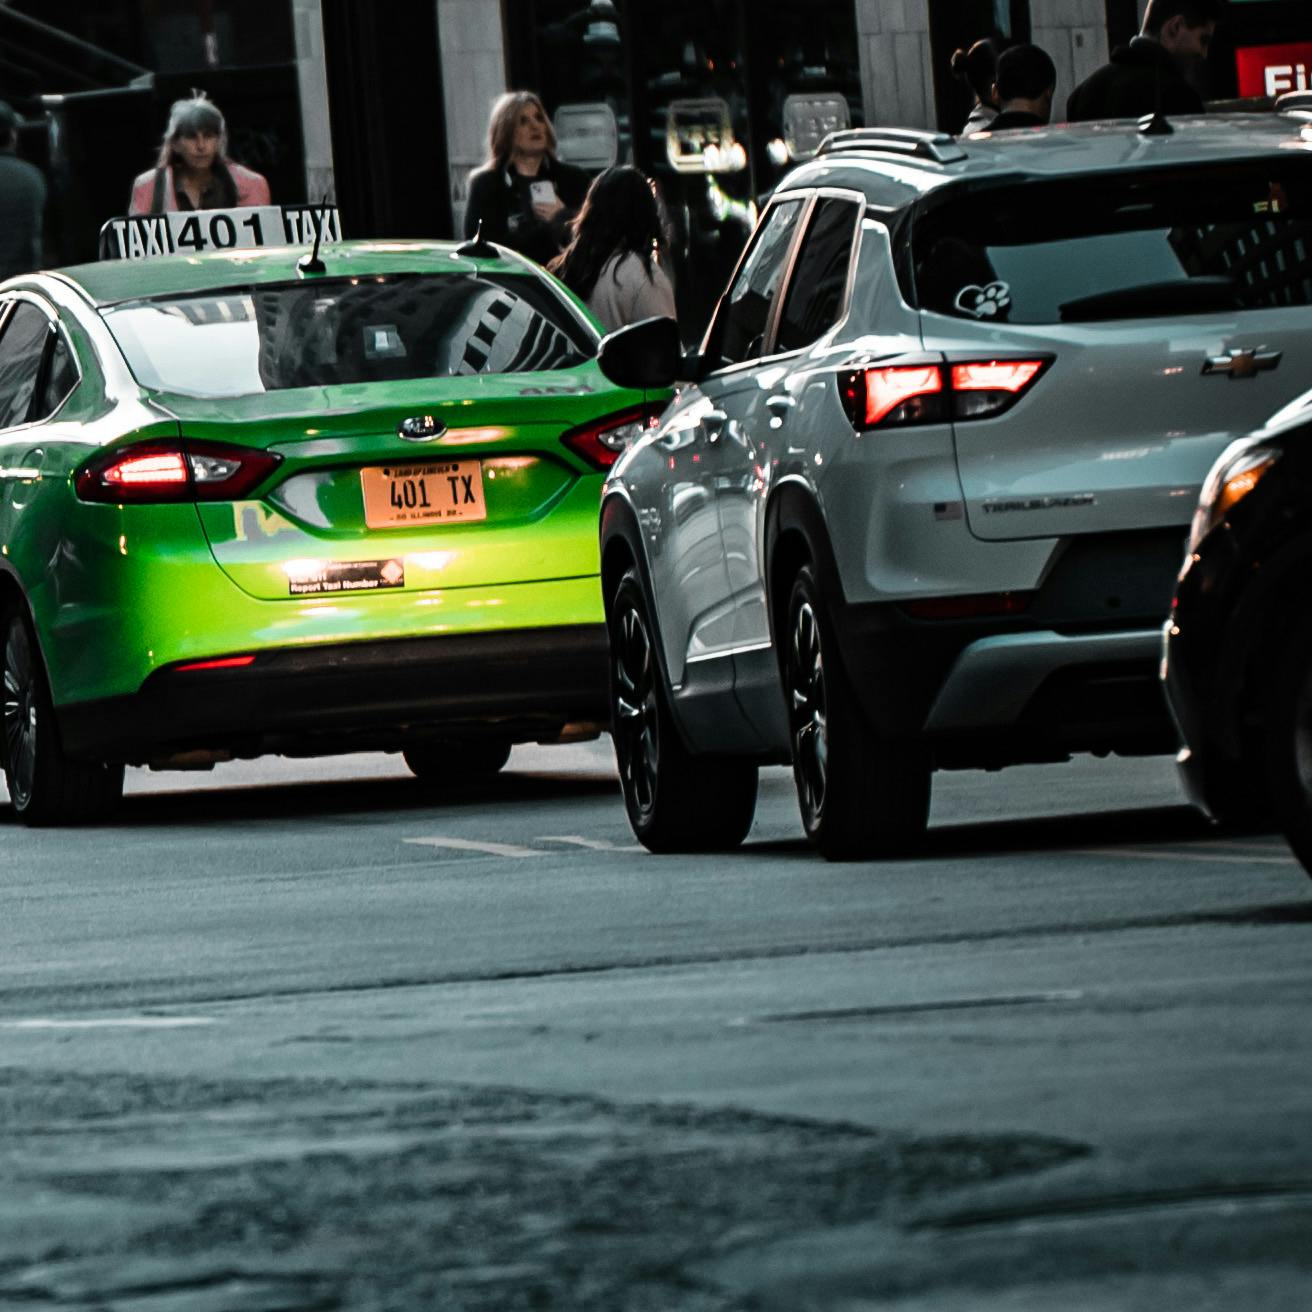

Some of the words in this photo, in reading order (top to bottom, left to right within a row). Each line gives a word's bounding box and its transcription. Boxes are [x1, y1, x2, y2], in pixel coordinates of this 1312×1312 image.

[1264, 63, 1312, 97] Fi
[113, 218, 172, 259] TAXI
[177, 213, 264, 251] 401
[286, 209, 343, 245] TAXI
[391, 478, 431, 510] 401
[447, 475, 475, 505] TX
